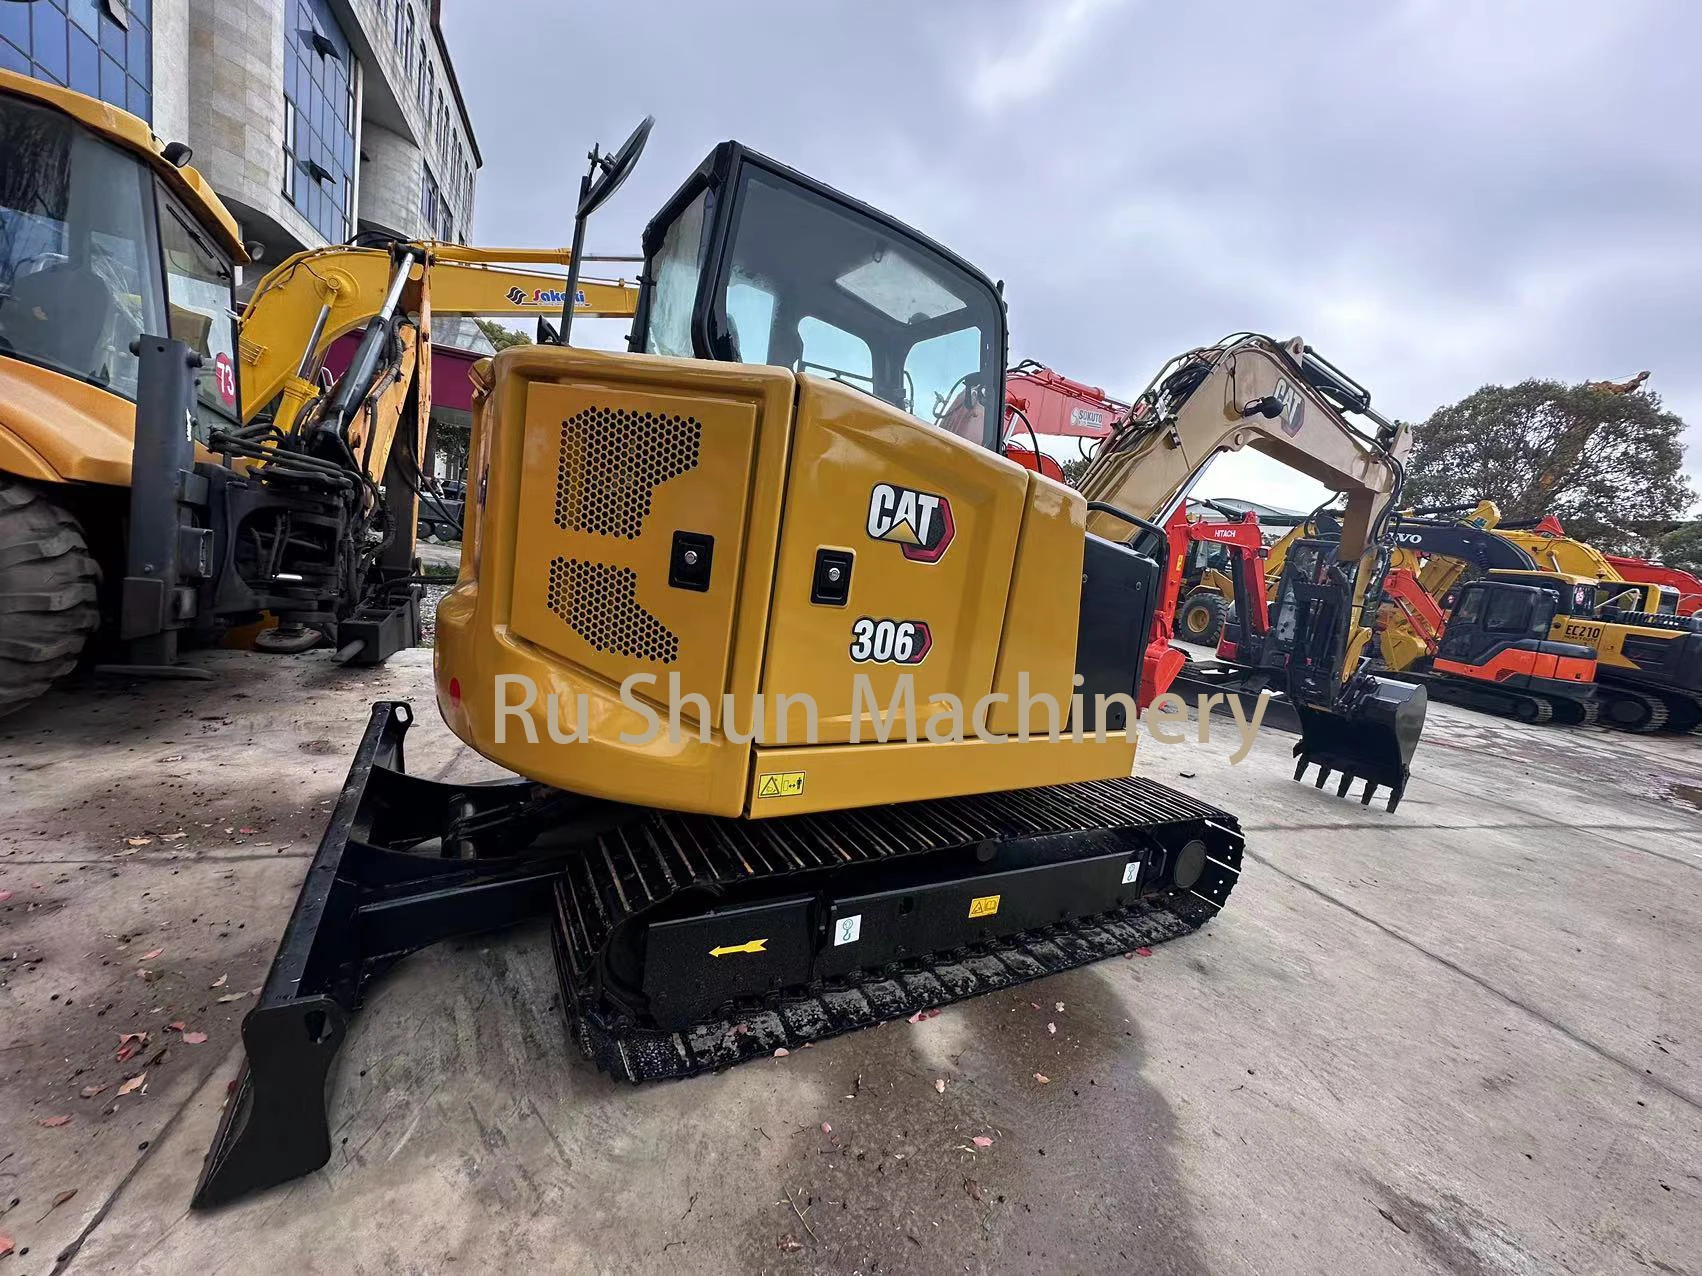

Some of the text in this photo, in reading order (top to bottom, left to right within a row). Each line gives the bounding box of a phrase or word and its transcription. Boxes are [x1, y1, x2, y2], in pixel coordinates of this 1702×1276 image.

[216, 361, 235, 396] 73
[1273, 378, 1303, 425] CAT
[867, 483, 940, 546] CAT
[1214, 529, 1236, 538] HITACHI
[852, 619, 915, 661] 306
[1565, 624, 1600, 639] EC210
